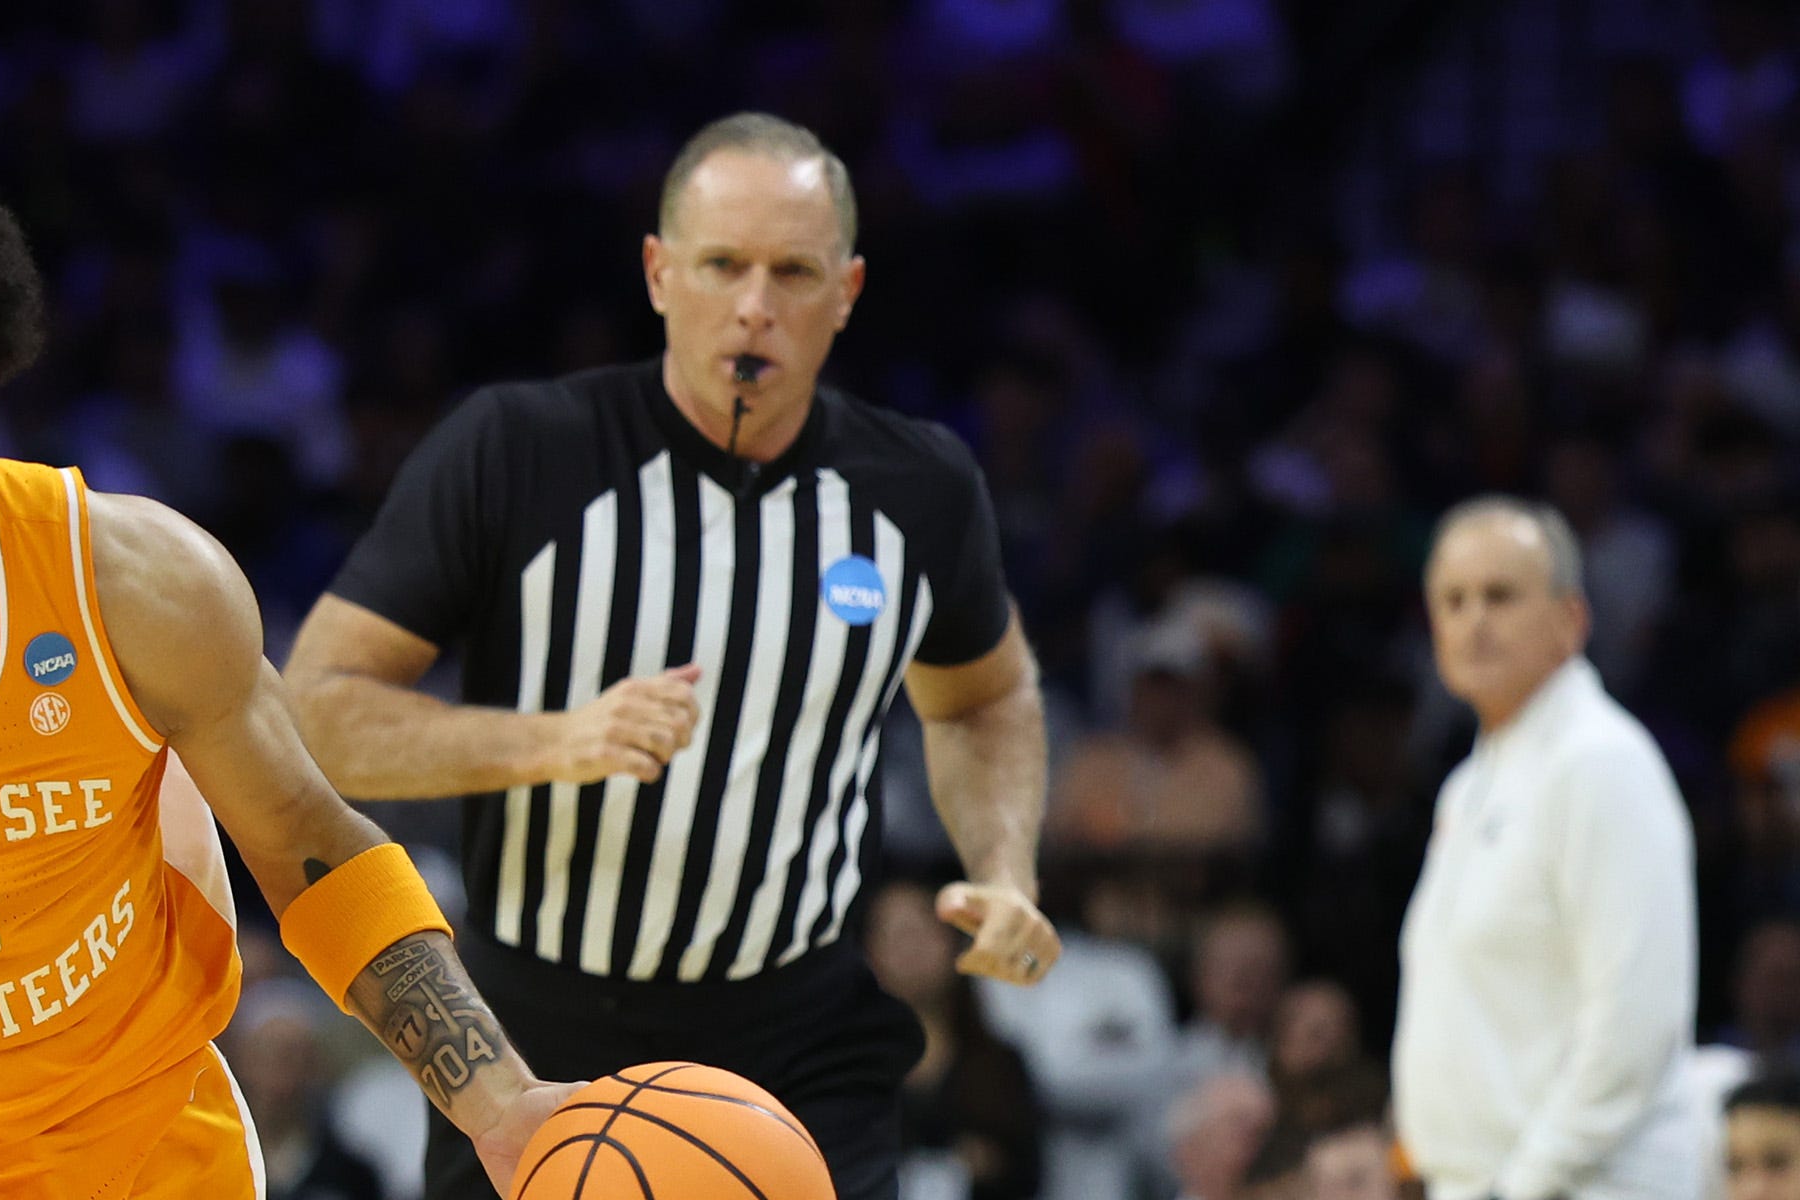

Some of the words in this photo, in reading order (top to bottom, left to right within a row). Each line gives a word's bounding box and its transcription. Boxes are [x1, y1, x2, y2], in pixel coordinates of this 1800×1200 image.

[33, 652, 75, 677] NCAA
[33, 696, 67, 732] SEC
[375, 950, 411, 972] PARK
[391, 965, 426, 999] COLONY
[395, 1014, 422, 1053] 77
[420, 1026, 496, 1104] 704
